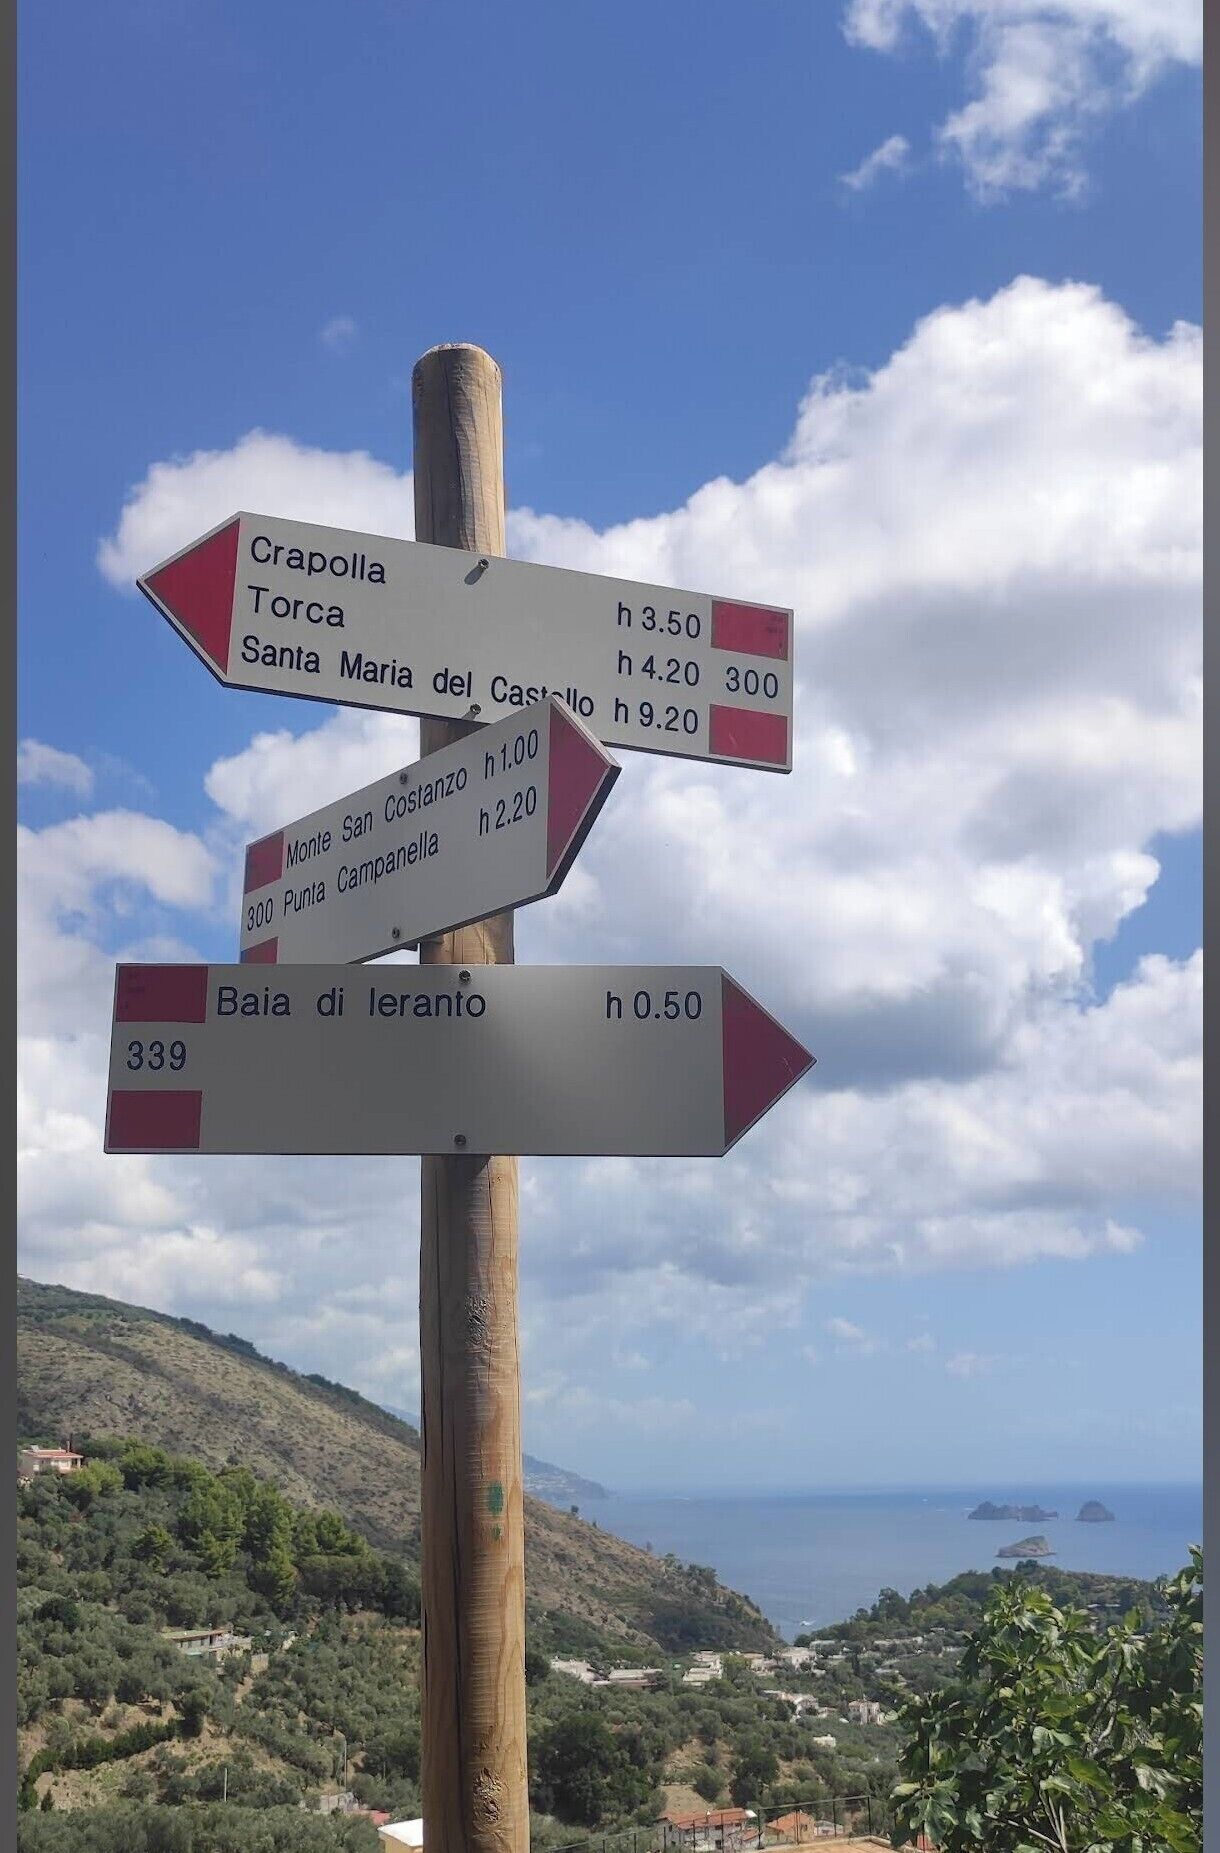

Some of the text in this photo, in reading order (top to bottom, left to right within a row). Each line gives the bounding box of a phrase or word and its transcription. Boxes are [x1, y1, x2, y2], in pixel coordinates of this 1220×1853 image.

[251, 535, 387, 585] Crapolla
[247, 584, 345, 628] Torca
[240, 634, 321, 674] Santa
[340, 650, 414, 689] Maria
[432, 667, 473, 698] del
[725, 666, 779, 699] 300
[286, 830, 332, 870] Monte
[342, 810, 374, 843] San
[384, 767, 468, 824] Costanzo
[283, 880, 327, 917] Punta
[337, 831, 440, 894] Campanella
[247, 897, 274, 933] 300
[216, 985, 292, 1017] Baia
[316, 986, 345, 1018] di
[368, 986, 487, 1019] Ieranto
[126, 1040, 188, 1072] 339
